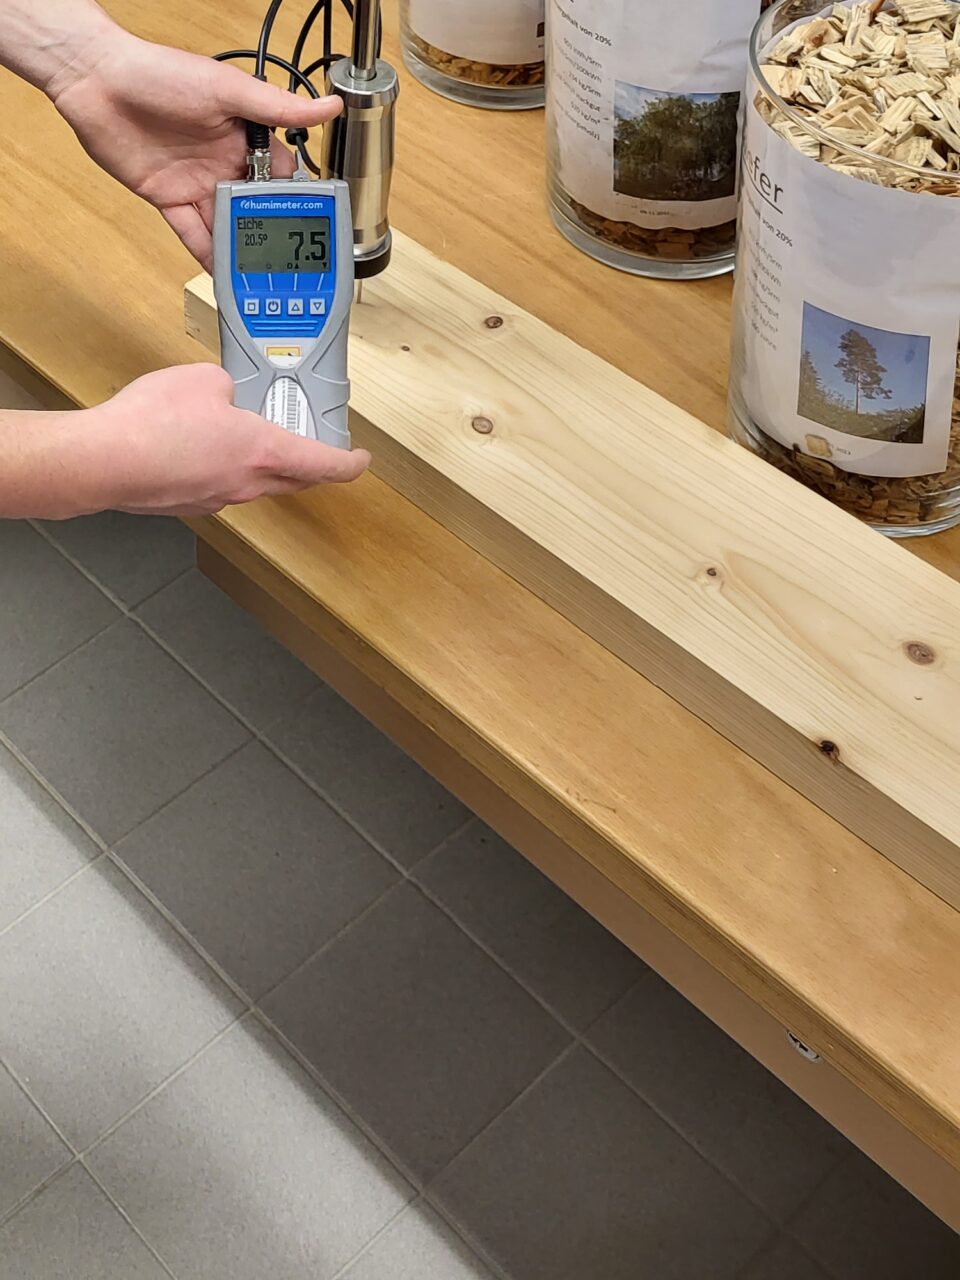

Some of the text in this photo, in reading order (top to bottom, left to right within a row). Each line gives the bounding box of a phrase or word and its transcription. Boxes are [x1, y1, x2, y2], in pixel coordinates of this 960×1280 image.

[580, 25, 593, 37] von
[595, 32, 612, 47] 20%
[744, 148, 784, 204] efer
[250, 199, 324, 210] humimeter.com
[237, 217, 264, 230] Eiche
[288, 231, 326, 261] 7.5
[776, 228, 793, 248] 20%
